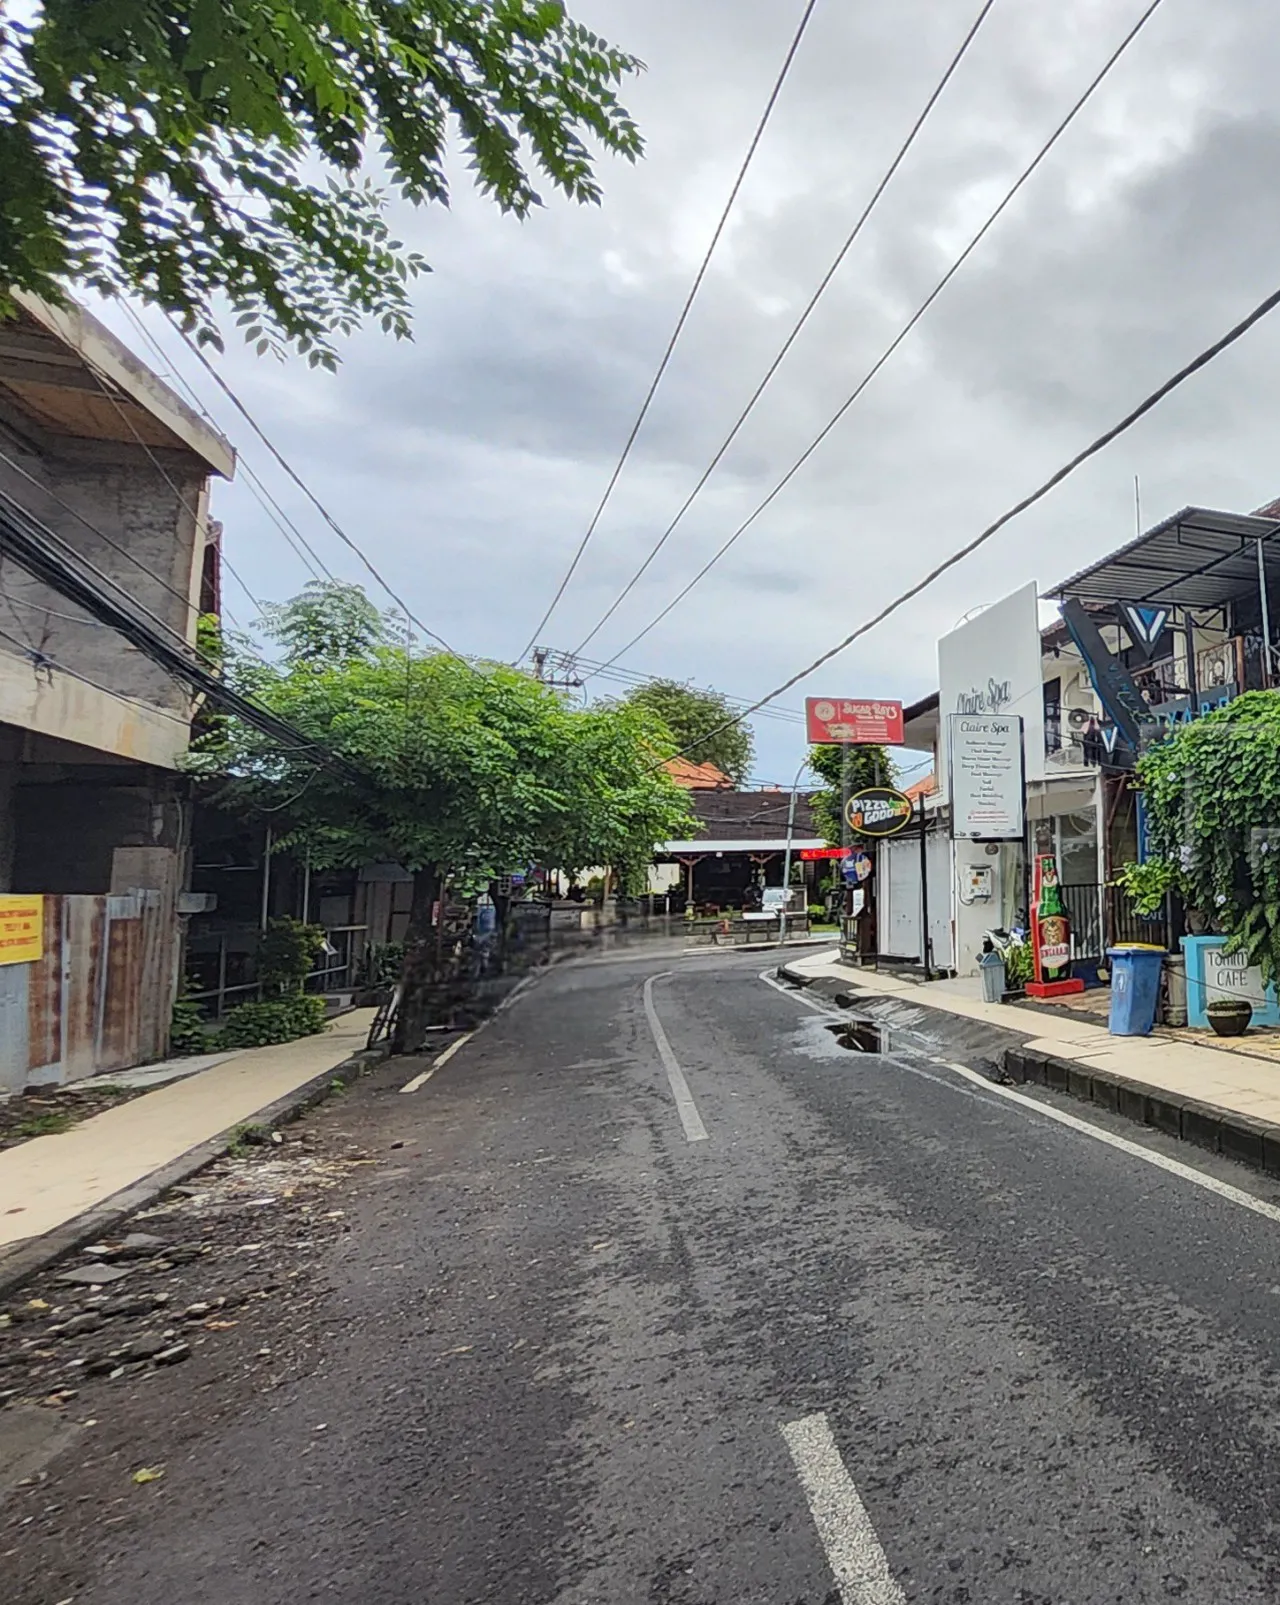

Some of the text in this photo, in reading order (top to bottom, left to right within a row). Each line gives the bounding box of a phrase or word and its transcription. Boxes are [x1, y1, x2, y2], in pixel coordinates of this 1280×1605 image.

[960, 721, 1010, 735] Claire Spa
[852, 799, 890, 813] PIZZA
[1217, 970, 1248, 986] CAFE
